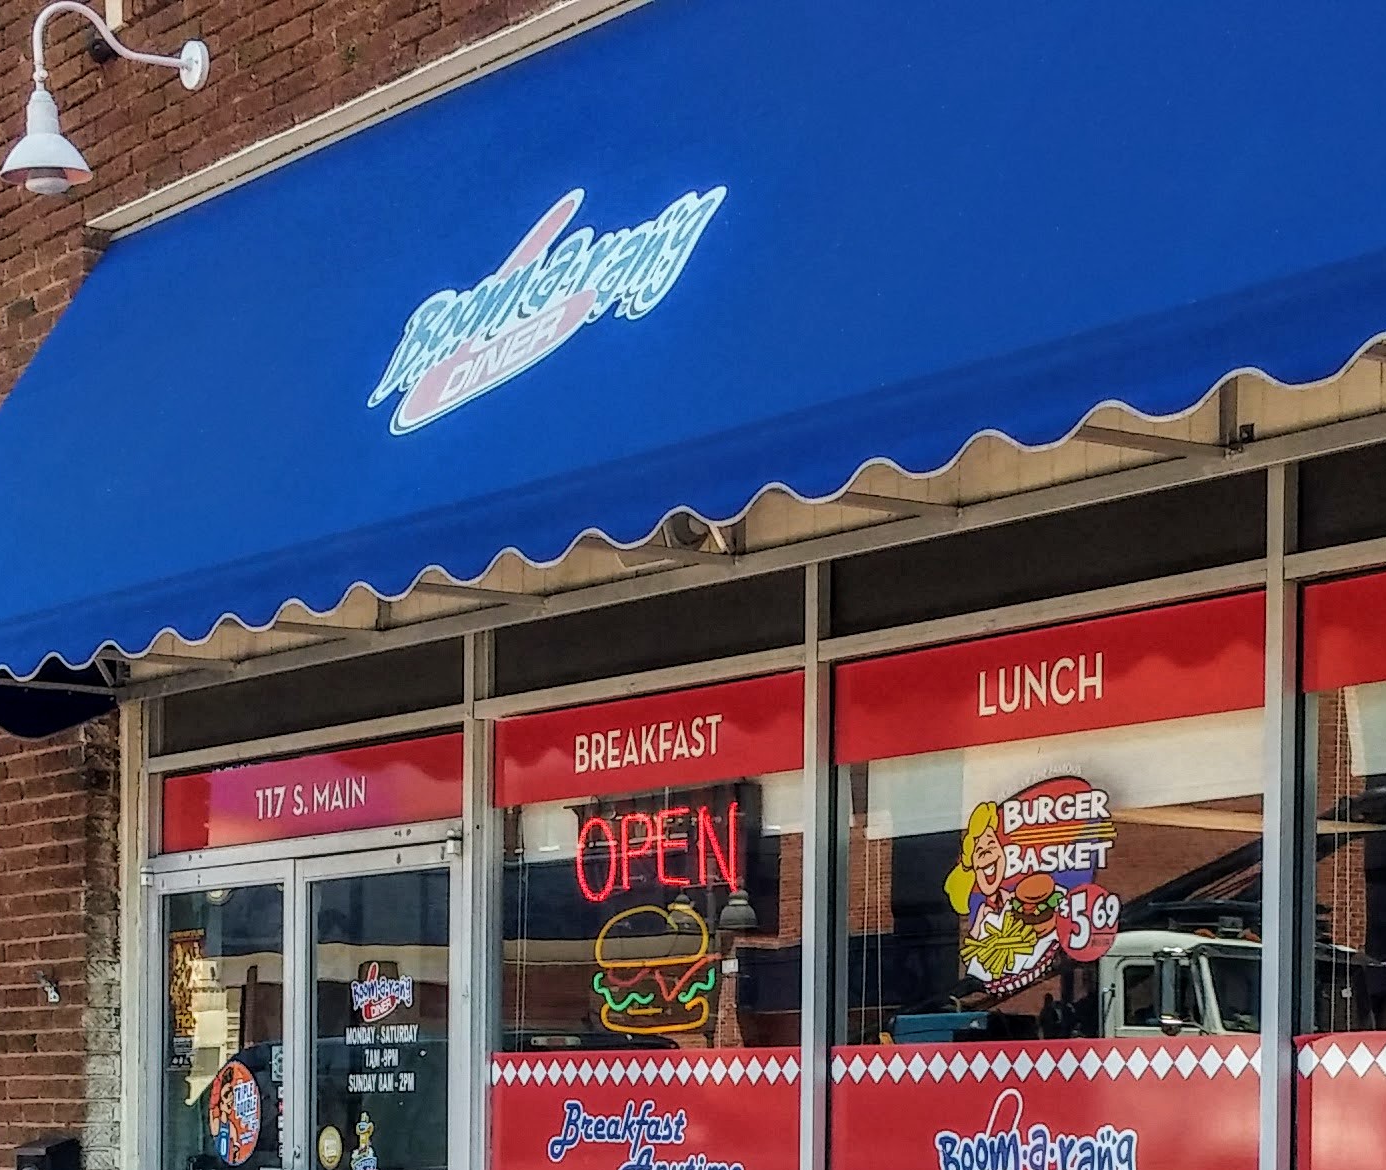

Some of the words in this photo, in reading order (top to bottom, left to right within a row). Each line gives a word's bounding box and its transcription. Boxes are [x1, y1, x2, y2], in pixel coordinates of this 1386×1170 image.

[439, 309, 566, 405] DINER
[977, 652, 1104, 717] LUNCH
[575, 714, 723, 774] BREAKFAST
[256, 786, 285, 821] 117
[292, 784, 309, 816] S.
[312, 776, 367, 814] MAIN
[1004, 790, 1111, 835] BURGER
[575, 802, 740, 903] OPEN
[1004, 841, 1114, 878] BASKET
[370, 998, 392, 1018] DINER
[346, 1026, 376, 1045] MONDAY
[381, 1024, 418, 1044] SATURDAY
[364, 1049, 380, 1067] 7AM
[348, 1074, 376, 1093] SUNDAY
[378, 1073, 394, 1092] 8AM
[399, 1073, 415, 1091] 2PM
[548, 1100, 686, 1163] Breakfast
